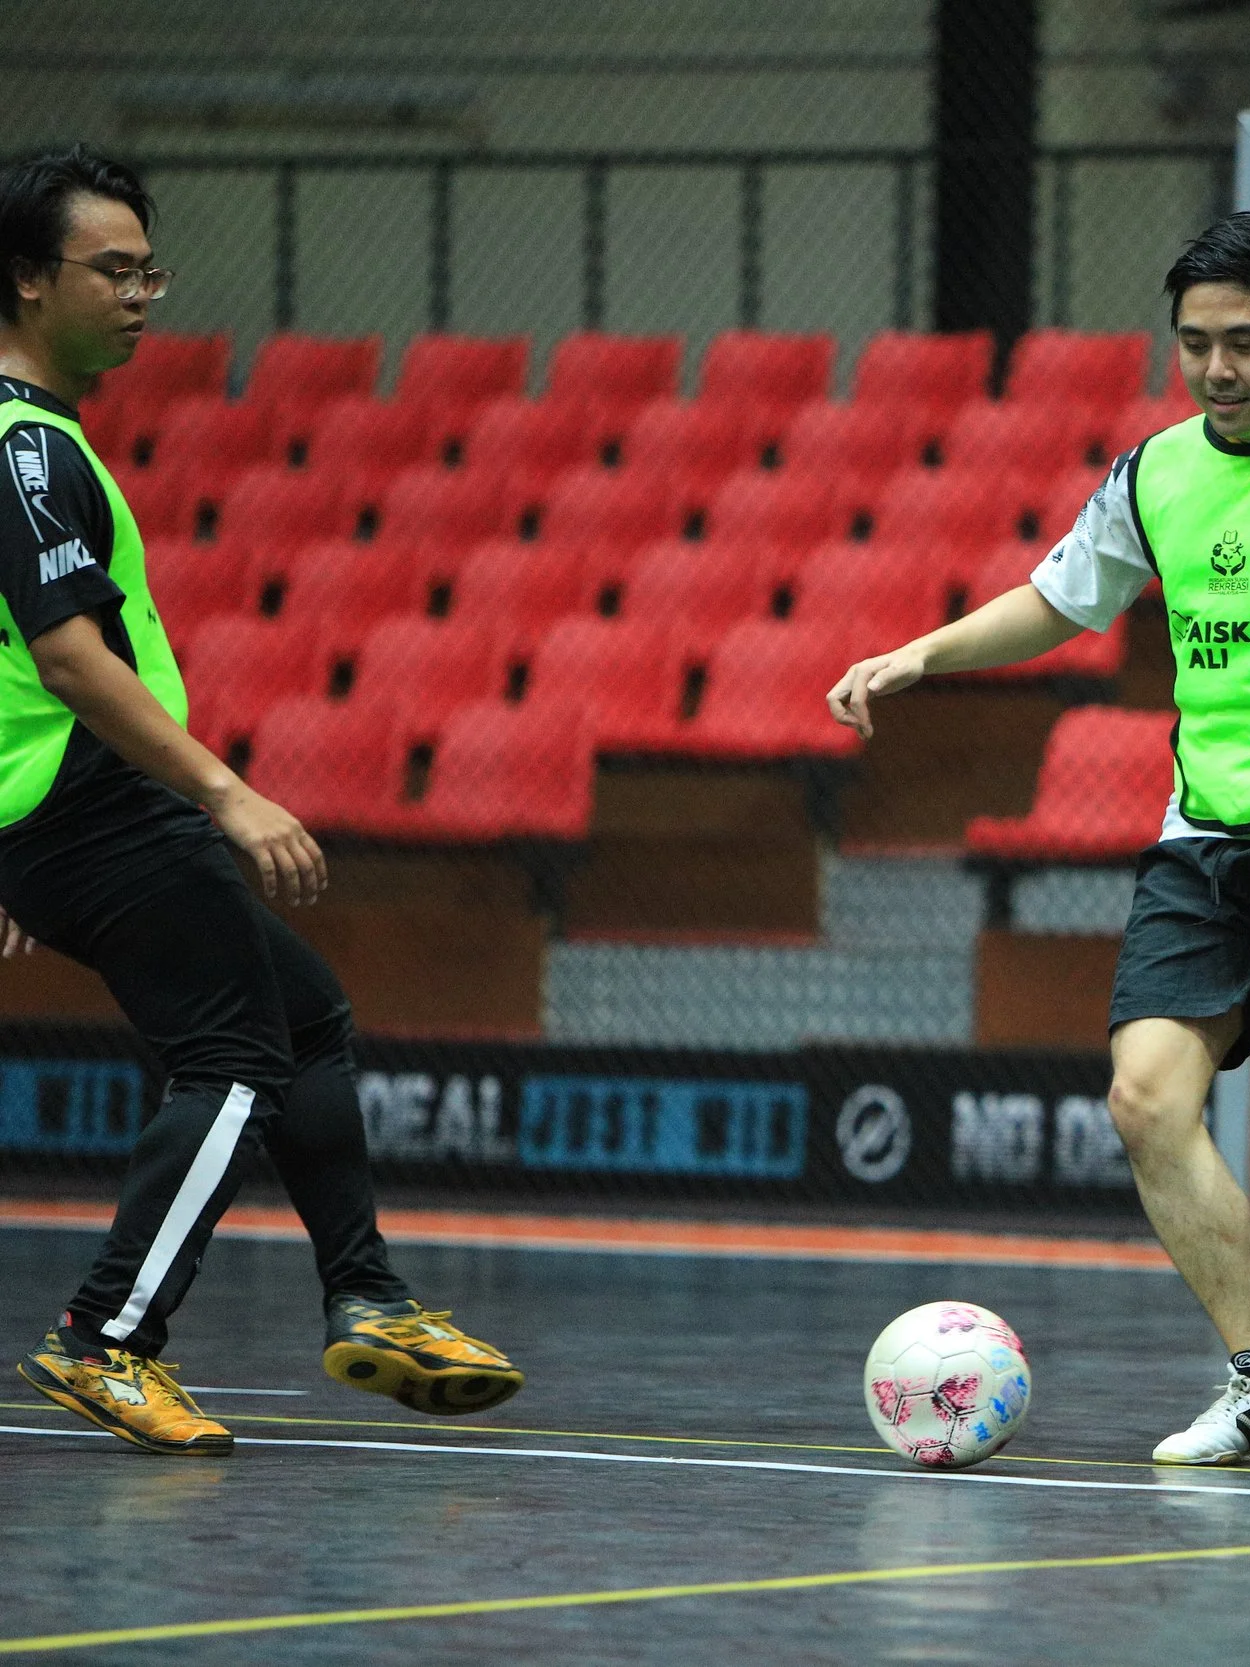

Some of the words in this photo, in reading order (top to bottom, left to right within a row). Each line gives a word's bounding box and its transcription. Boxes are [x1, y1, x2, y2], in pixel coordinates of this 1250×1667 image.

[15, 450, 48, 492] NIKE
[1208, 582, 1249, 591] REKREASI
[1189, 648, 1228, 669] ALI
[356, 1071, 512, 1160] DEAL
[952, 1090, 1045, 1184] NO
[1052, 1094, 1136, 1188] DE
